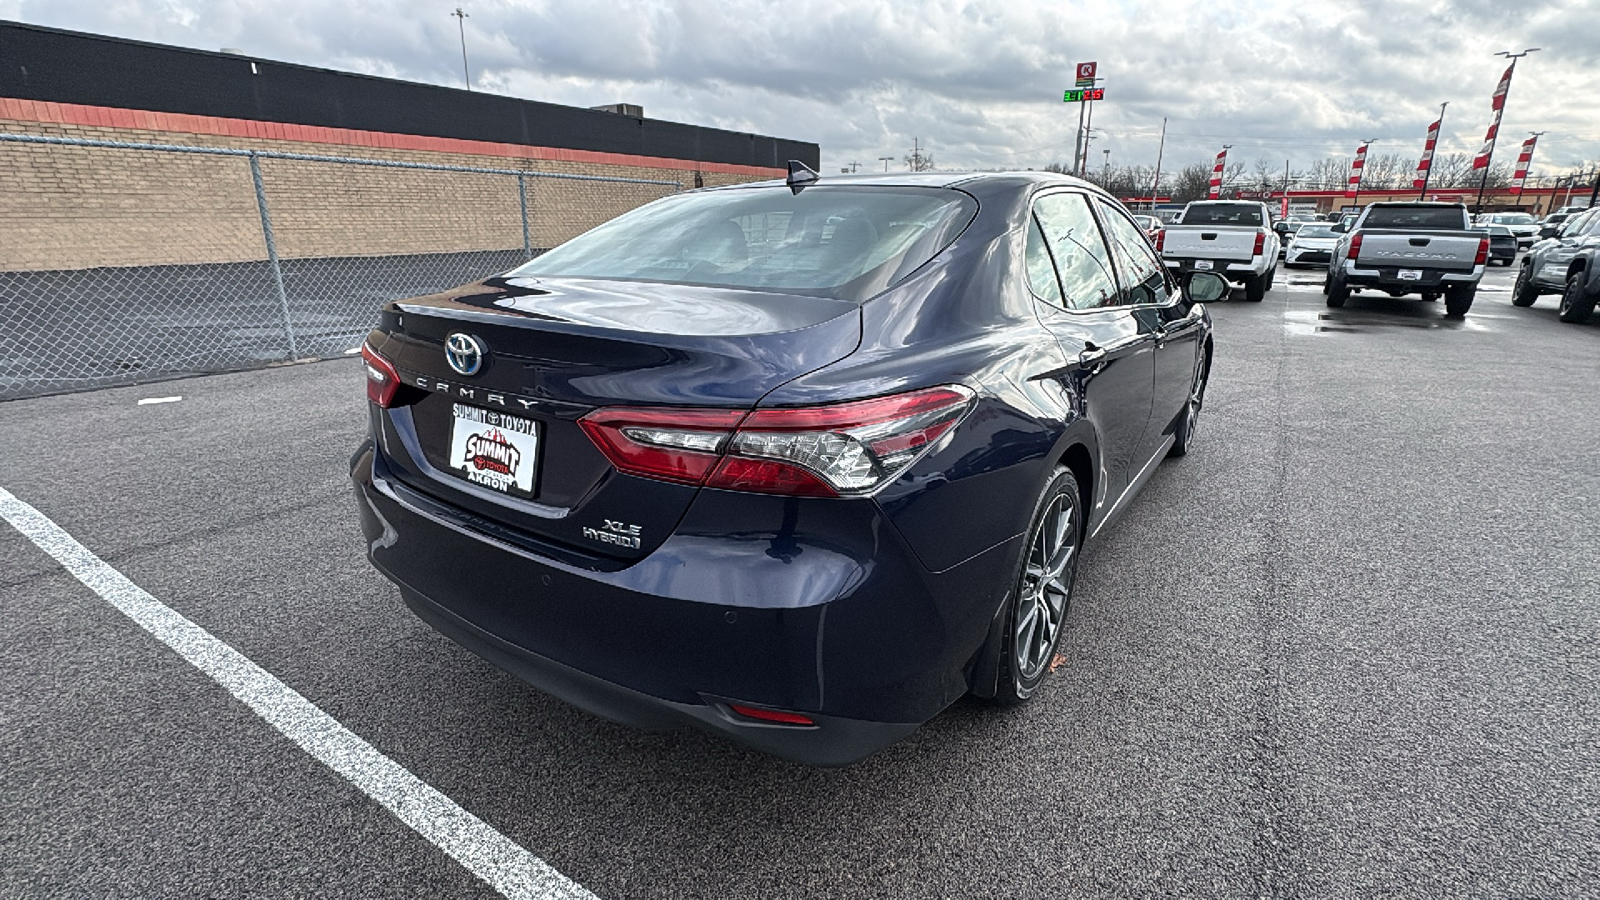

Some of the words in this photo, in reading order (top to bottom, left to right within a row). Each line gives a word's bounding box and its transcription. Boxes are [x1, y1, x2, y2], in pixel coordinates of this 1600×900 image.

[1377, 251, 1457, 259] TACOMA
[416, 377, 539, 409] CAMRY
[452, 402, 487, 424] SUMMIT
[500, 413, 537, 437] TOYOTA
[465, 435, 520, 474] SUMMIT
[485, 460, 509, 474] TOYOTA
[467, 471, 508, 492] AKRON
[582, 526, 634, 548] HYBRID
[602, 519, 642, 536] XLE
